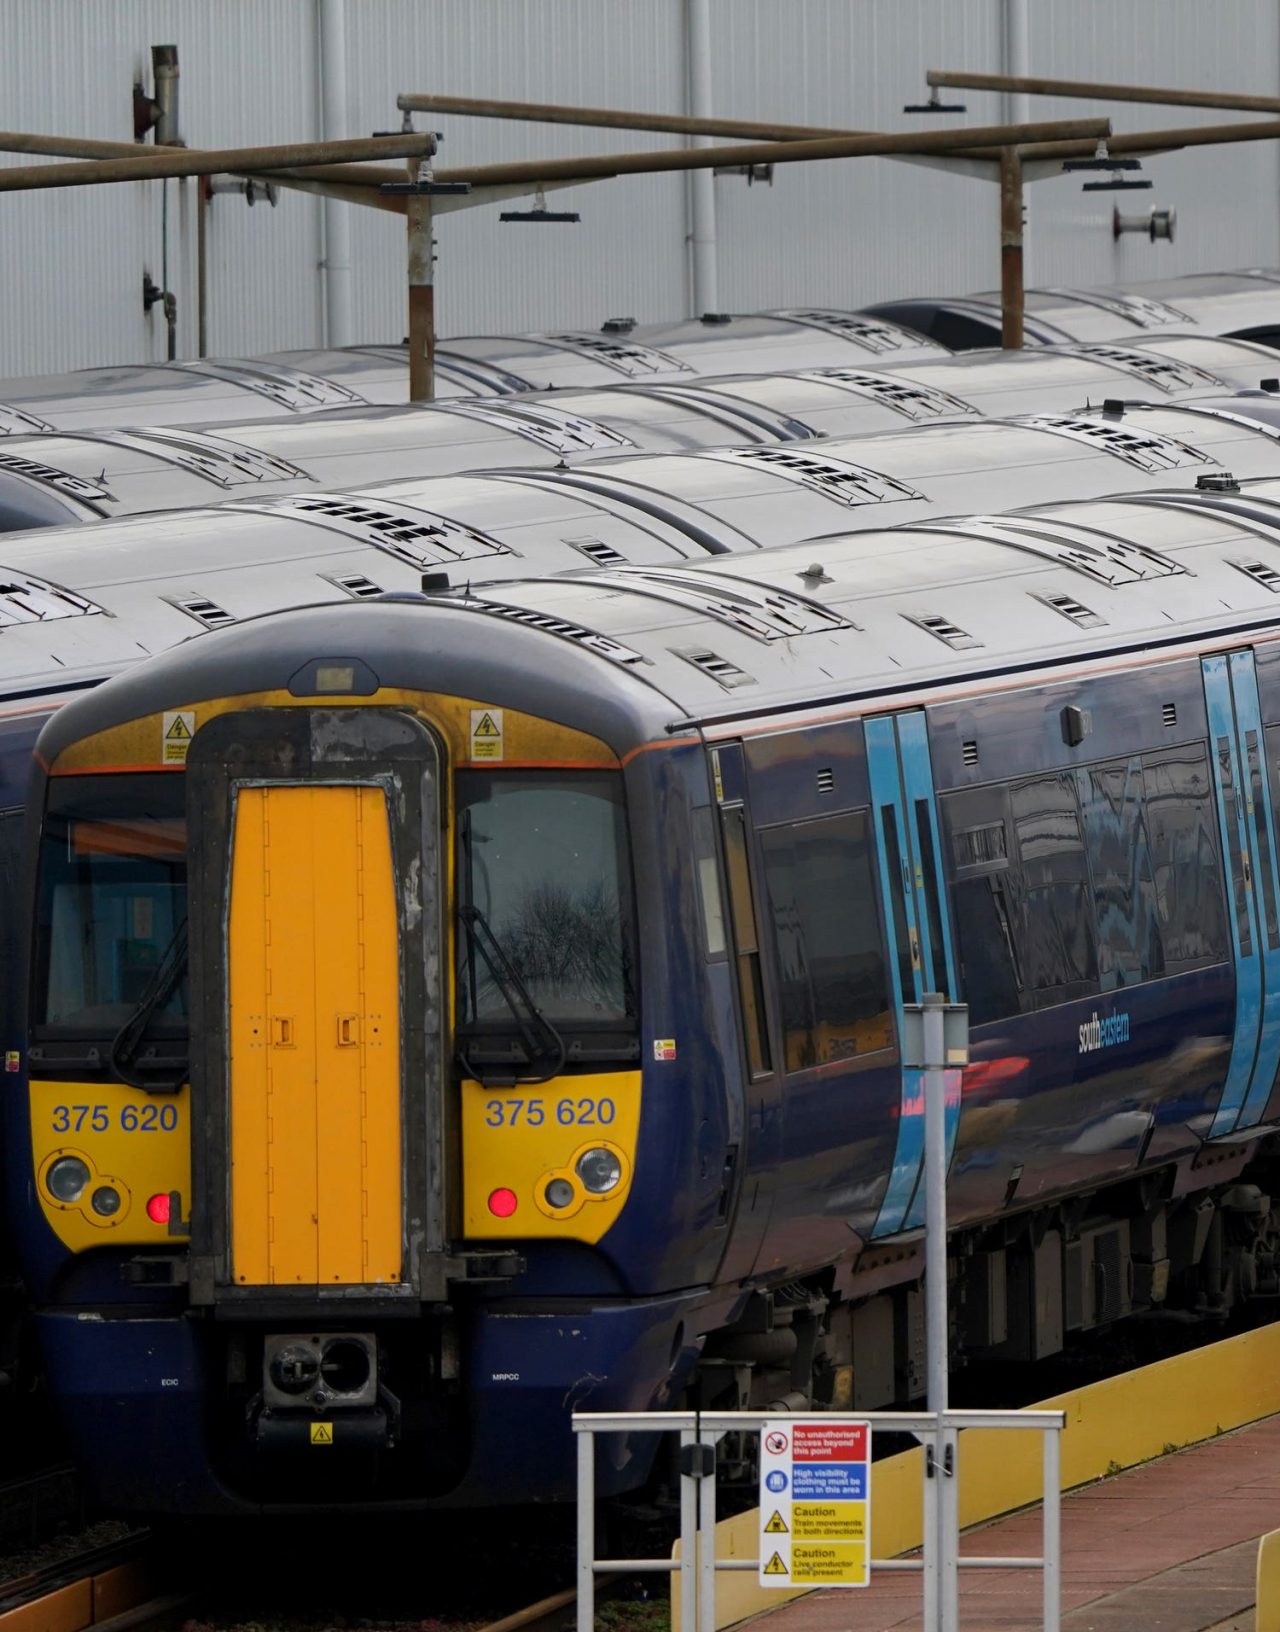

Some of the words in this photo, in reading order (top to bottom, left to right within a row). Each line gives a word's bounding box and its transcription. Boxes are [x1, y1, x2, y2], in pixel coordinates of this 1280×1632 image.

[486, 1099, 545, 1127] 375
[556, 1097, 615, 1125] 620
[52, 1105, 109, 1132] 375
[120, 1103, 178, 1132] 620
[793, 1430, 806, 1438] No
[823, 1439, 854, 1448] beyond
[793, 1447, 809, 1455] this
[810, 1447, 832, 1456] point
[793, 1469, 813, 1478] High
[814, 1469, 848, 1478] visibility
[793, 1478, 827, 1487] clothing
[827, 1478, 849, 1486] must
[849, 1478, 860, 1486] be
[825, 1486, 841, 1494] this
[794, 1507, 836, 1516] Caution
[793, 1548, 836, 1558] Caution
[812, 1569, 844, 1577] present
